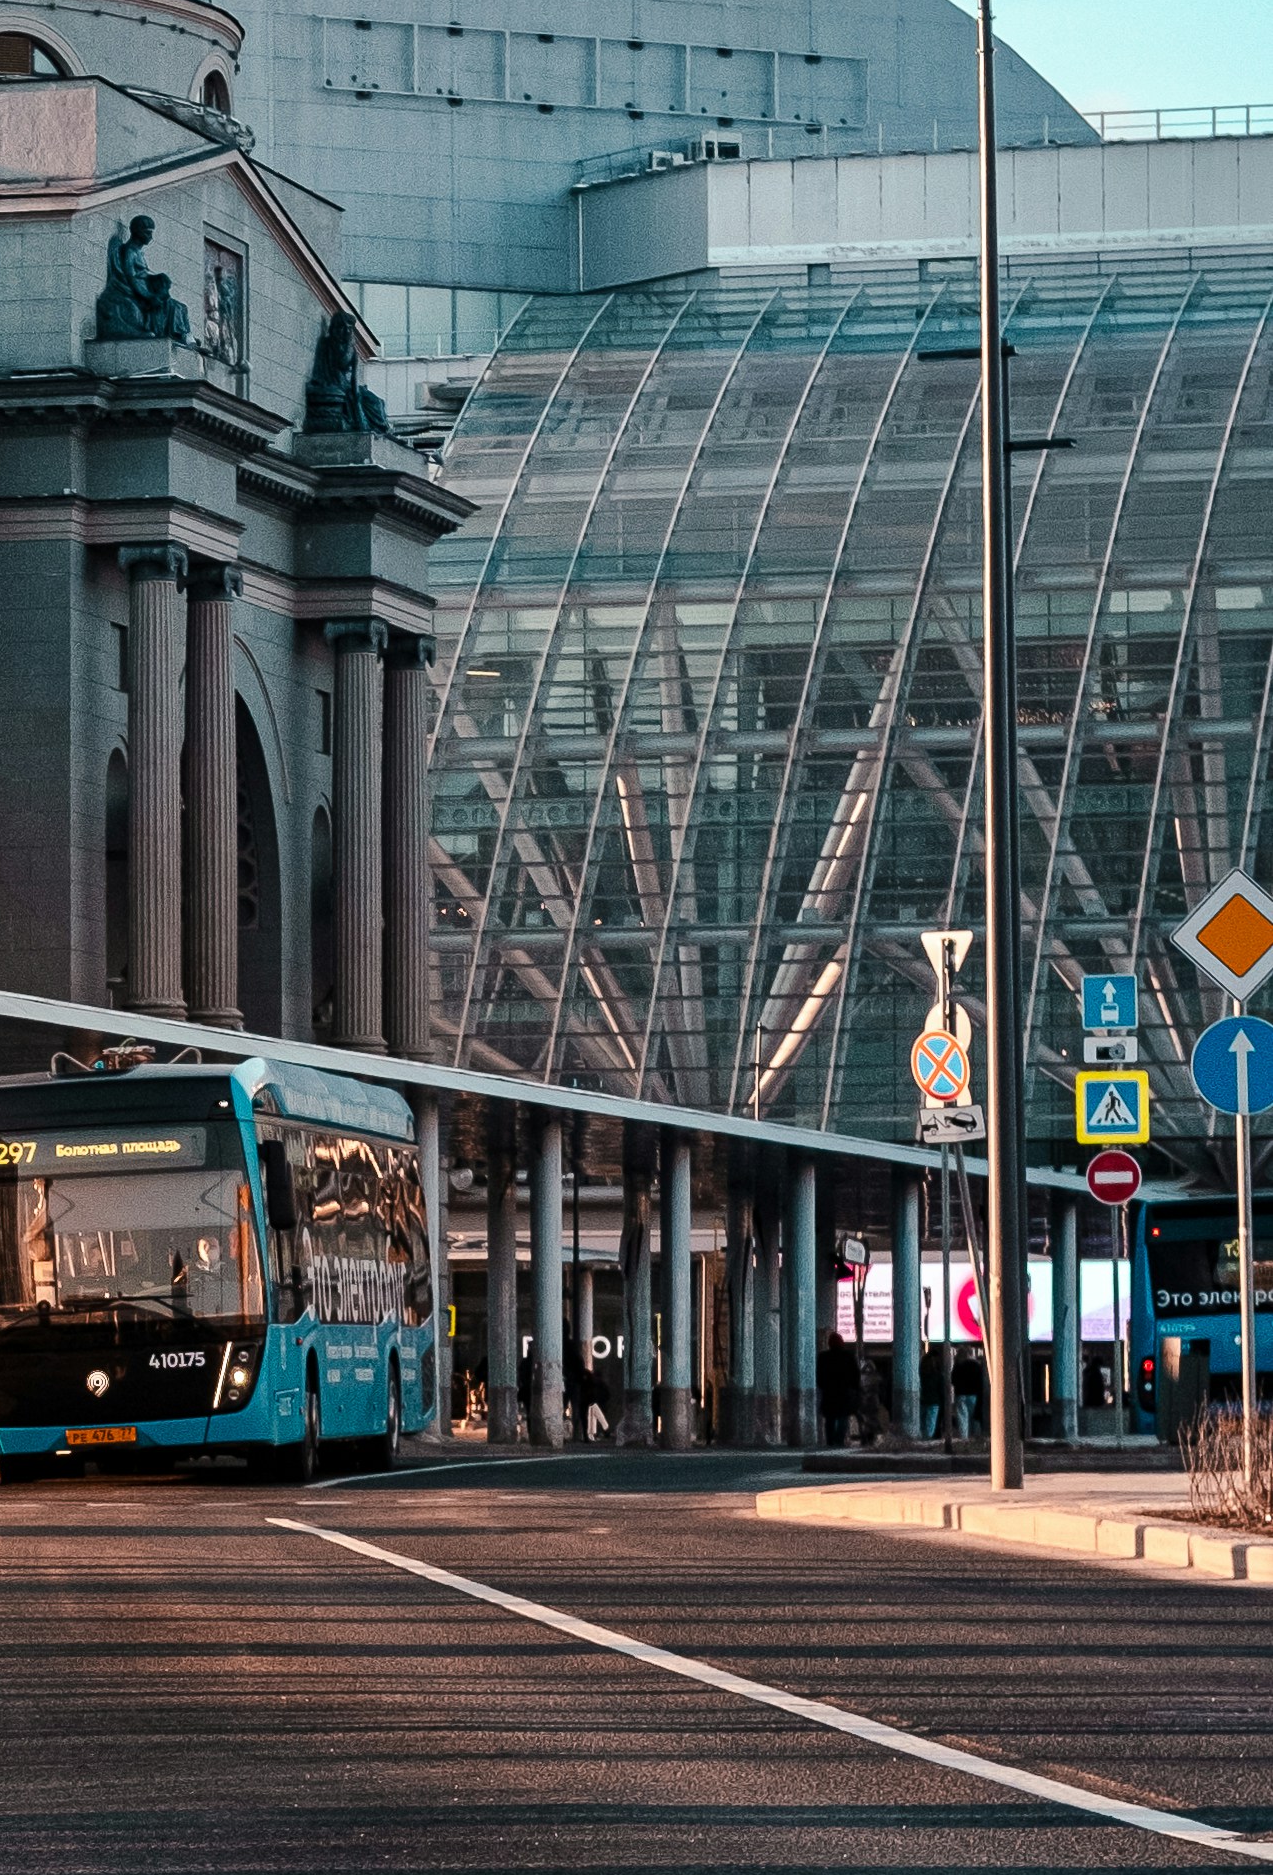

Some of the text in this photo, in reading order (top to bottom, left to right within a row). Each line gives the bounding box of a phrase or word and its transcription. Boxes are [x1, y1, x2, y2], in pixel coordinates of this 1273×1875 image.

[55, 1143, 118, 1158] Болотная
[122, 1140, 182, 1154] площадь
[1157, 1289, 1193, 1308] Это
[149, 1352, 206, 1369] 410175
